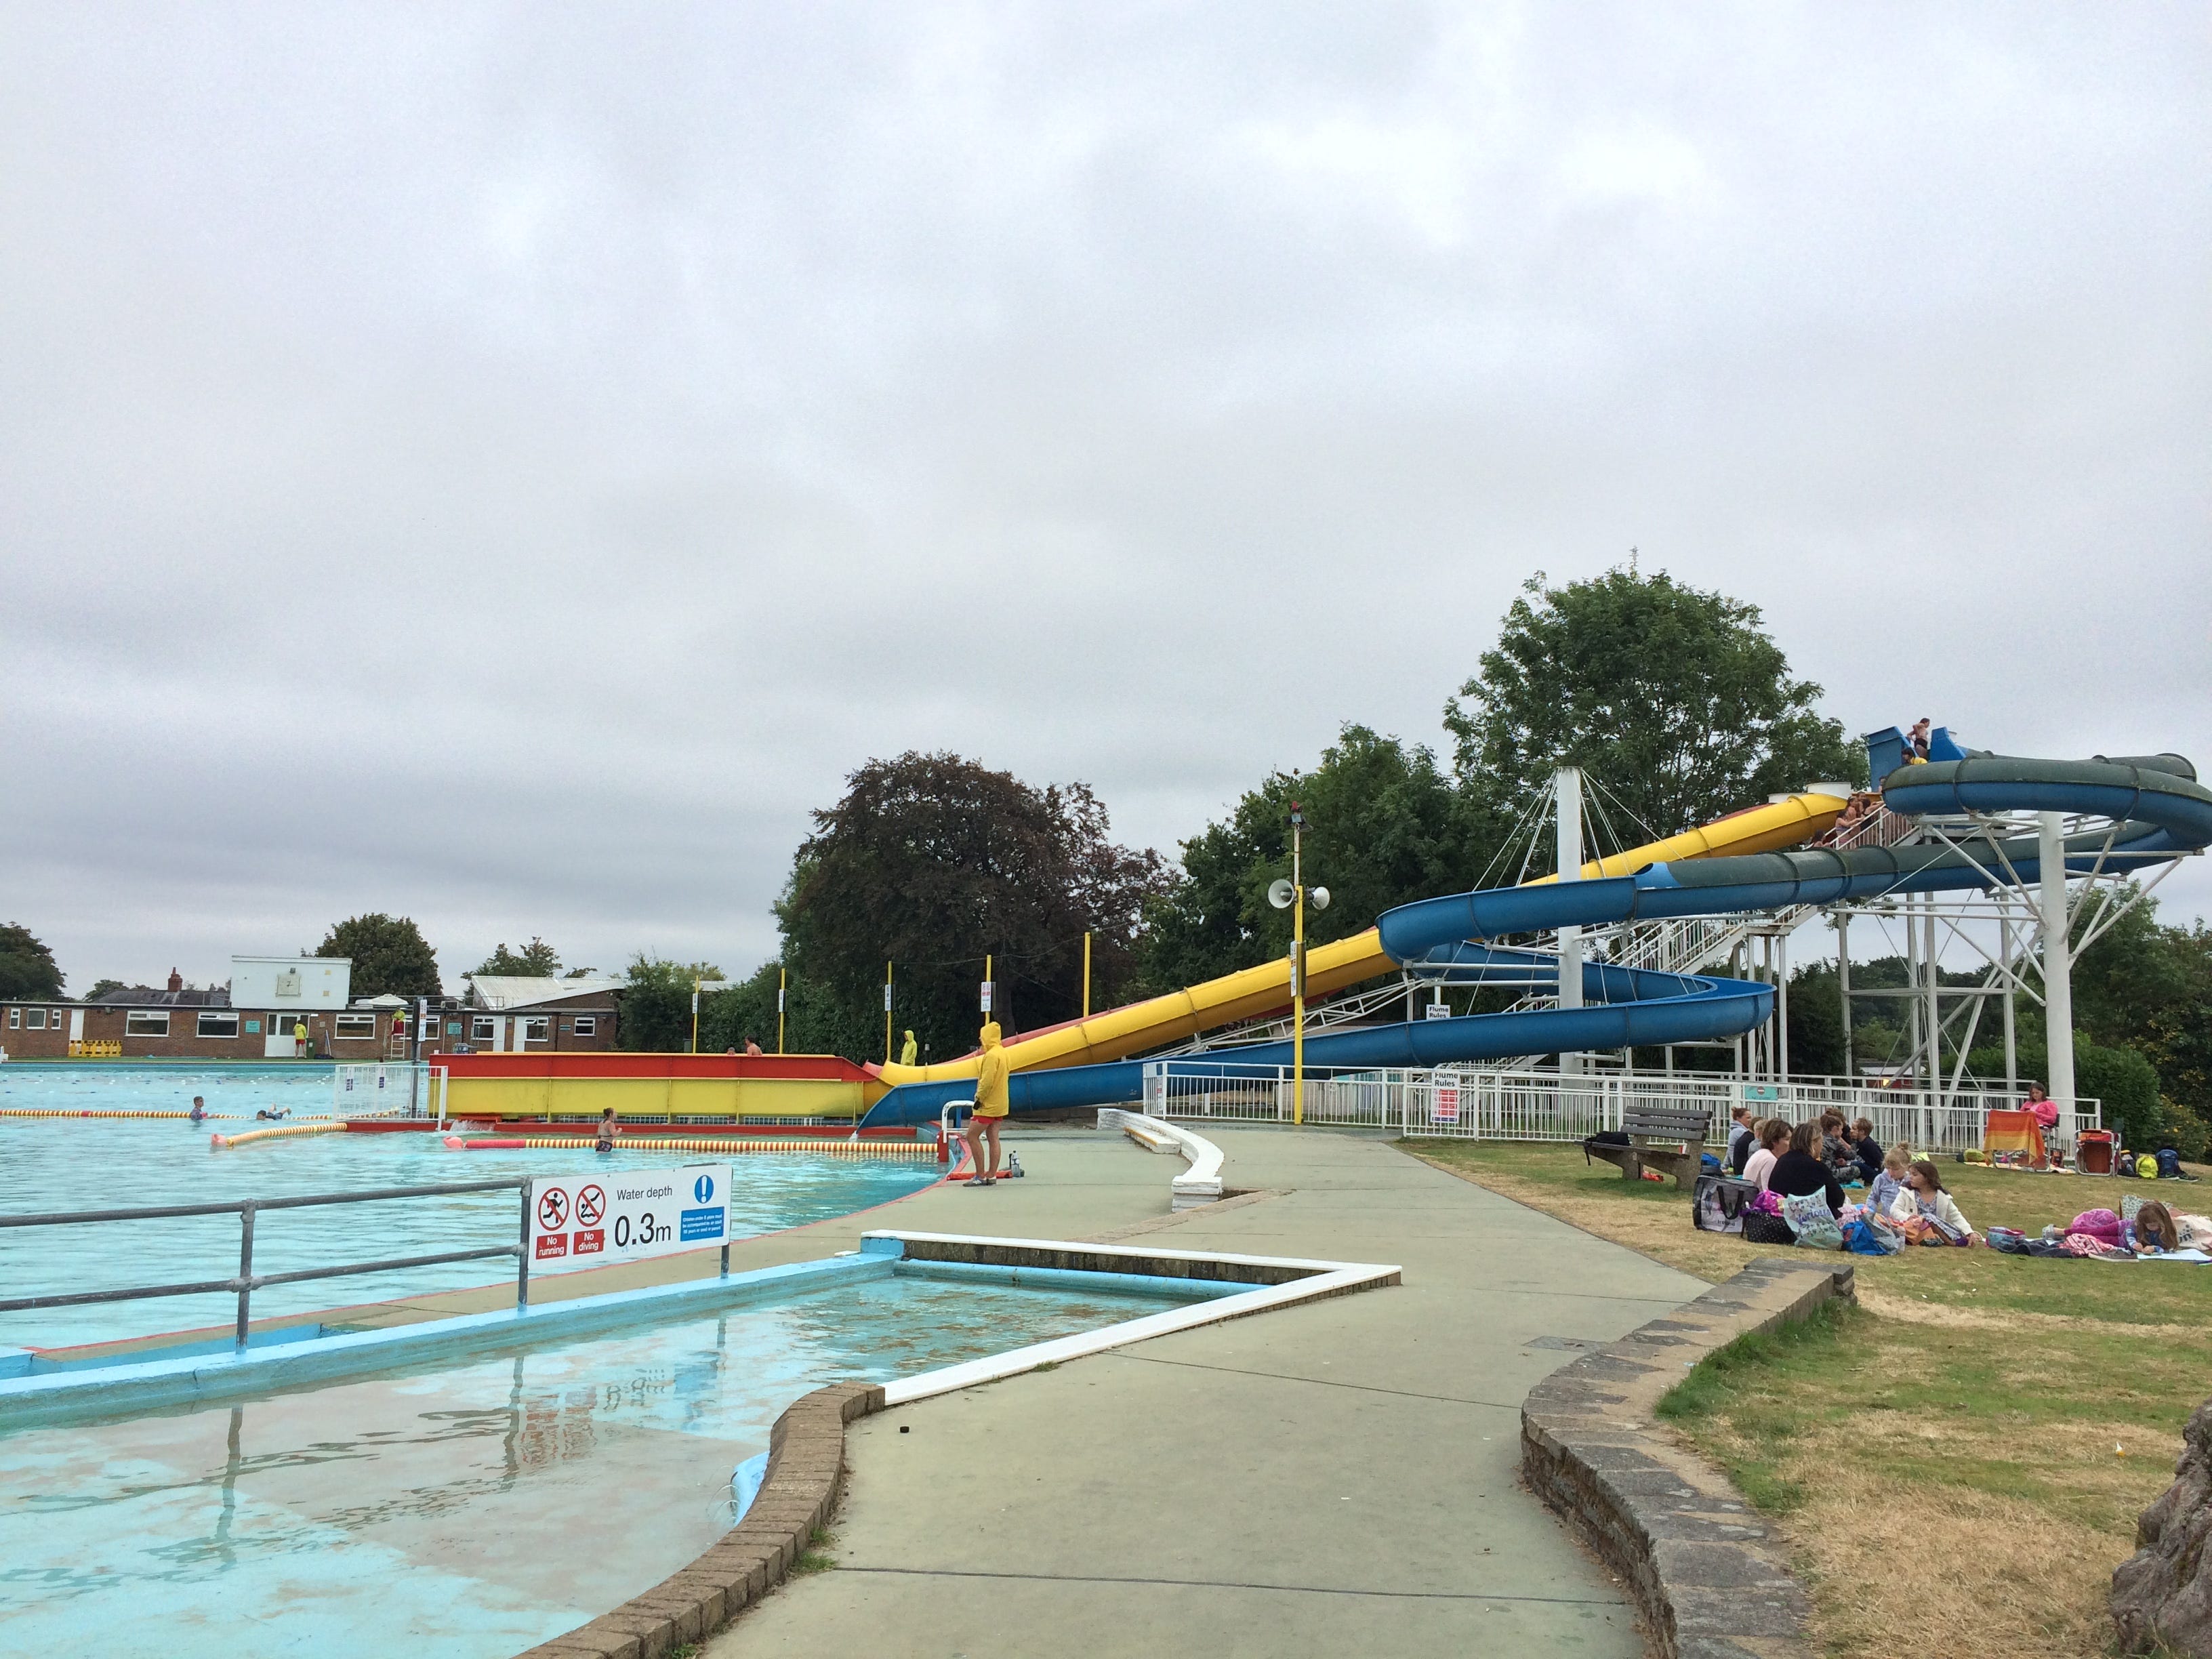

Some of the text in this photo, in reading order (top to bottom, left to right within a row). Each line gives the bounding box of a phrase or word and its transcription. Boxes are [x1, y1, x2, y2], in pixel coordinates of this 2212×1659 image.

[617, 1185, 672, 1200] Water depth
[615, 1212, 671, 1247] 0.3m
[547, 1236, 557, 1246] No
[583, 1232, 594, 1242] No
[539, 1246, 565, 1256] running
[578, 1242, 599, 1252] diving
